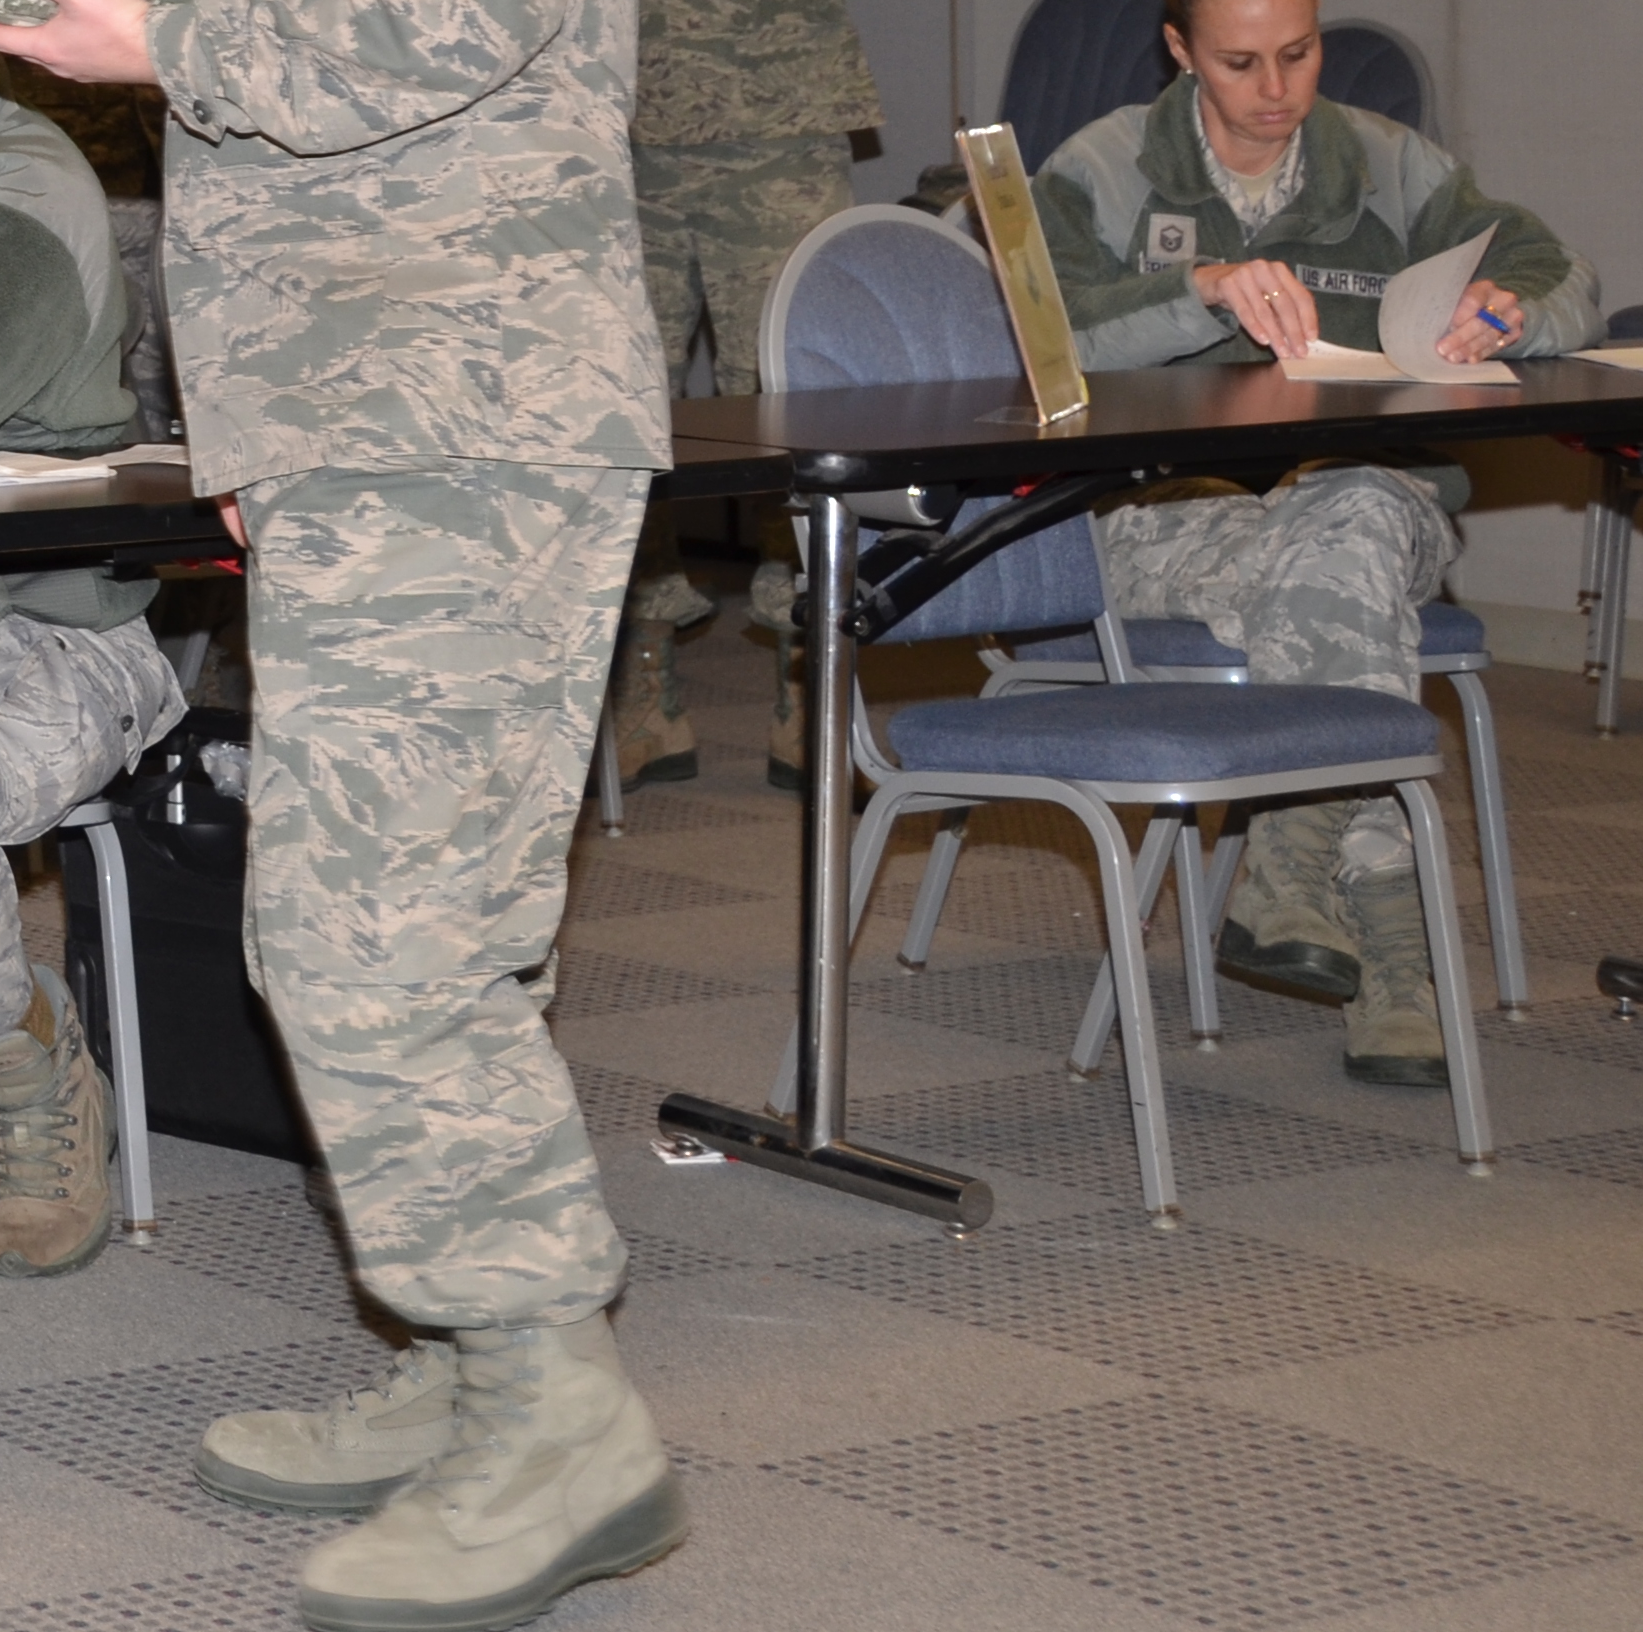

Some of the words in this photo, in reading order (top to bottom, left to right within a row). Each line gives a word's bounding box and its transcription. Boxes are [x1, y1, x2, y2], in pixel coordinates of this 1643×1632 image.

[1302, 268, 1319, 287] US
[1324, 272, 1348, 290] AIR
[1352, 274, 1387, 294] FORC
